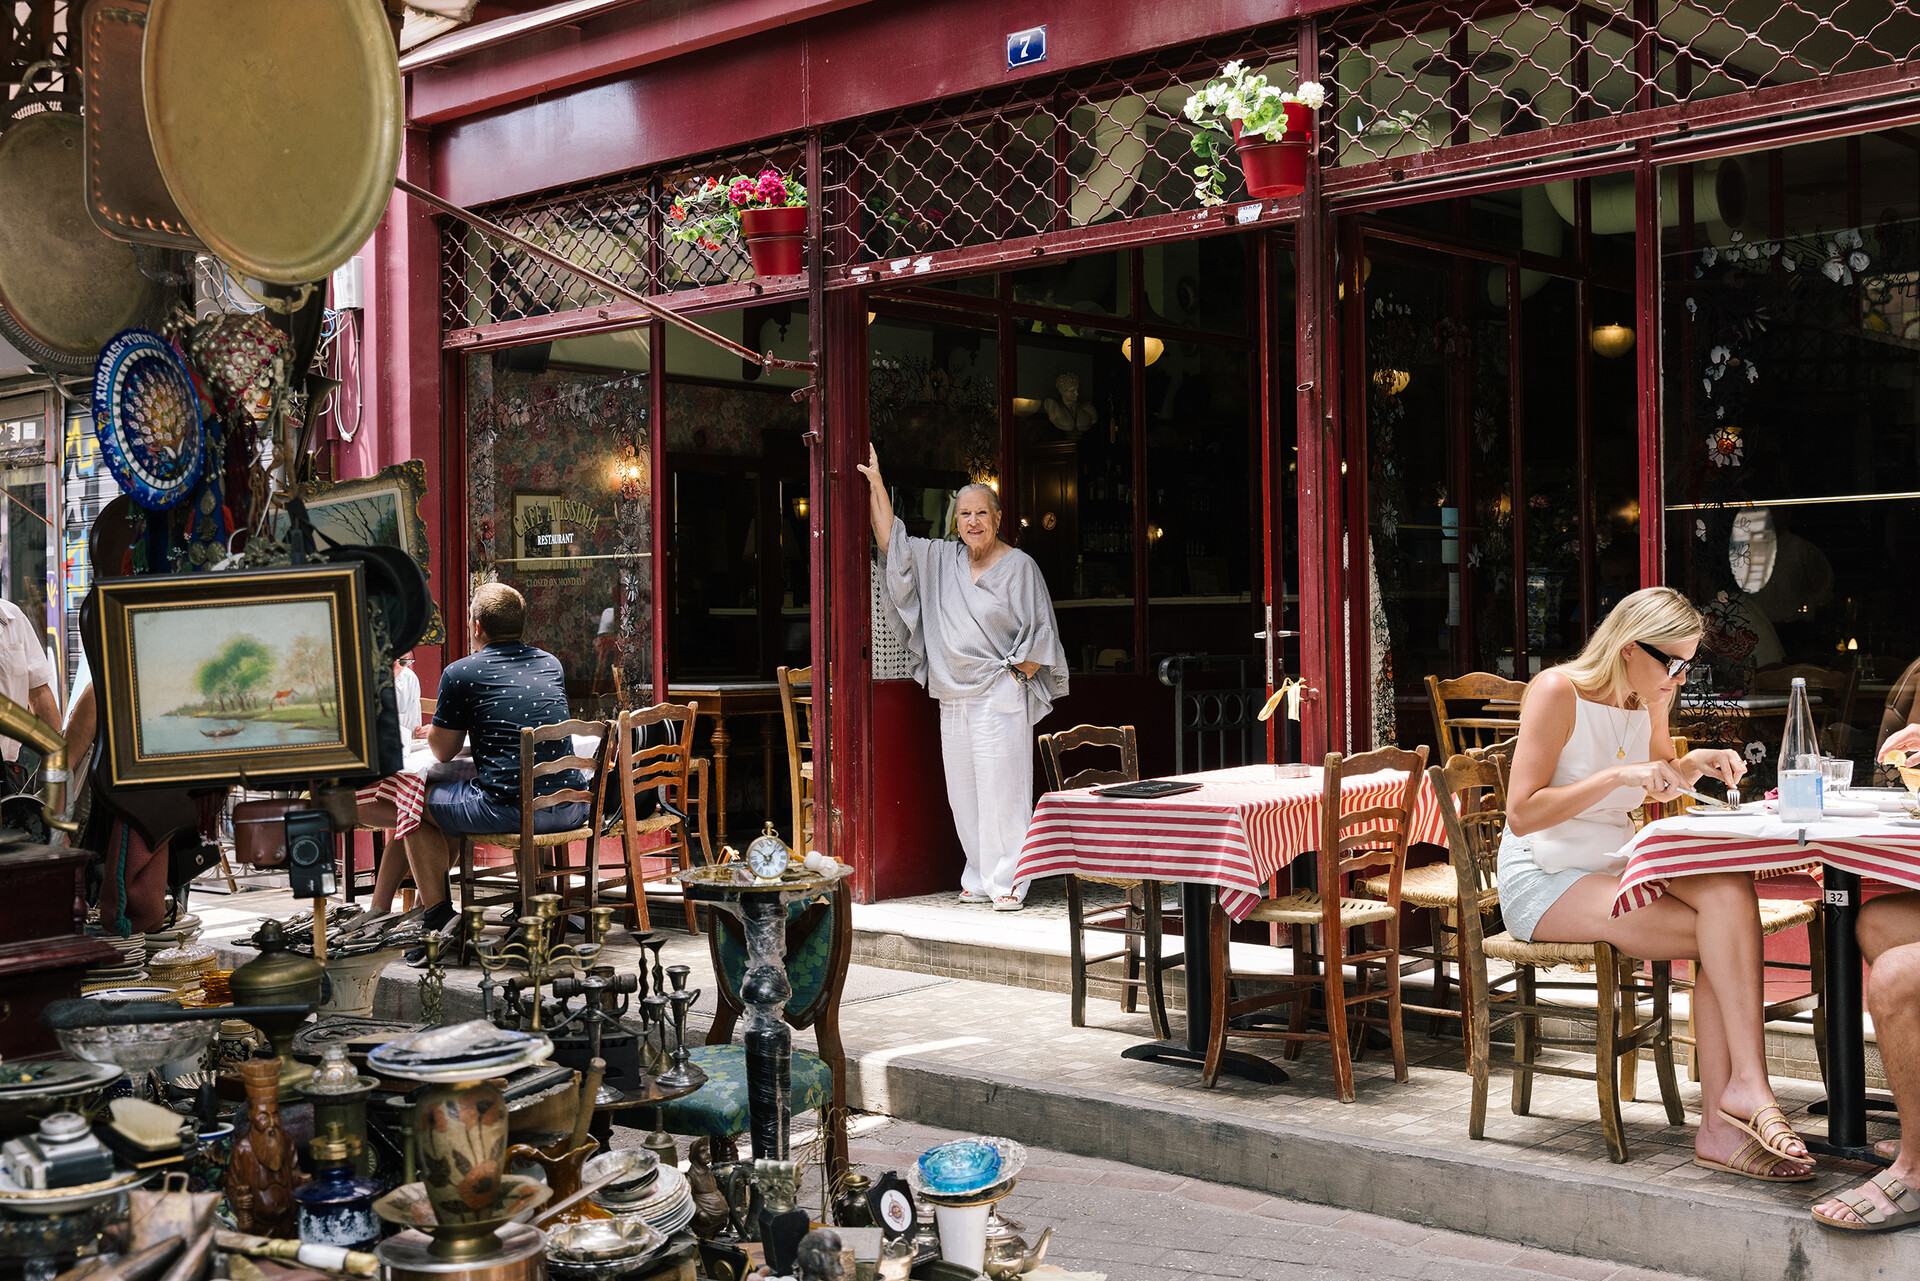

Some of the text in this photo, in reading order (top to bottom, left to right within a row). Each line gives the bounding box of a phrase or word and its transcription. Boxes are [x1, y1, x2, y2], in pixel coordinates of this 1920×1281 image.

[1020, 35, 1031, 58] 7
[513, 499, 600, 537] CAFÉ AVISSINIA
[537, 533, 574, 546] RESTAURANT
[526, 577, 586, 588] CLOSED ON MONDAYS
[1830, 893, 1844, 902] 32
